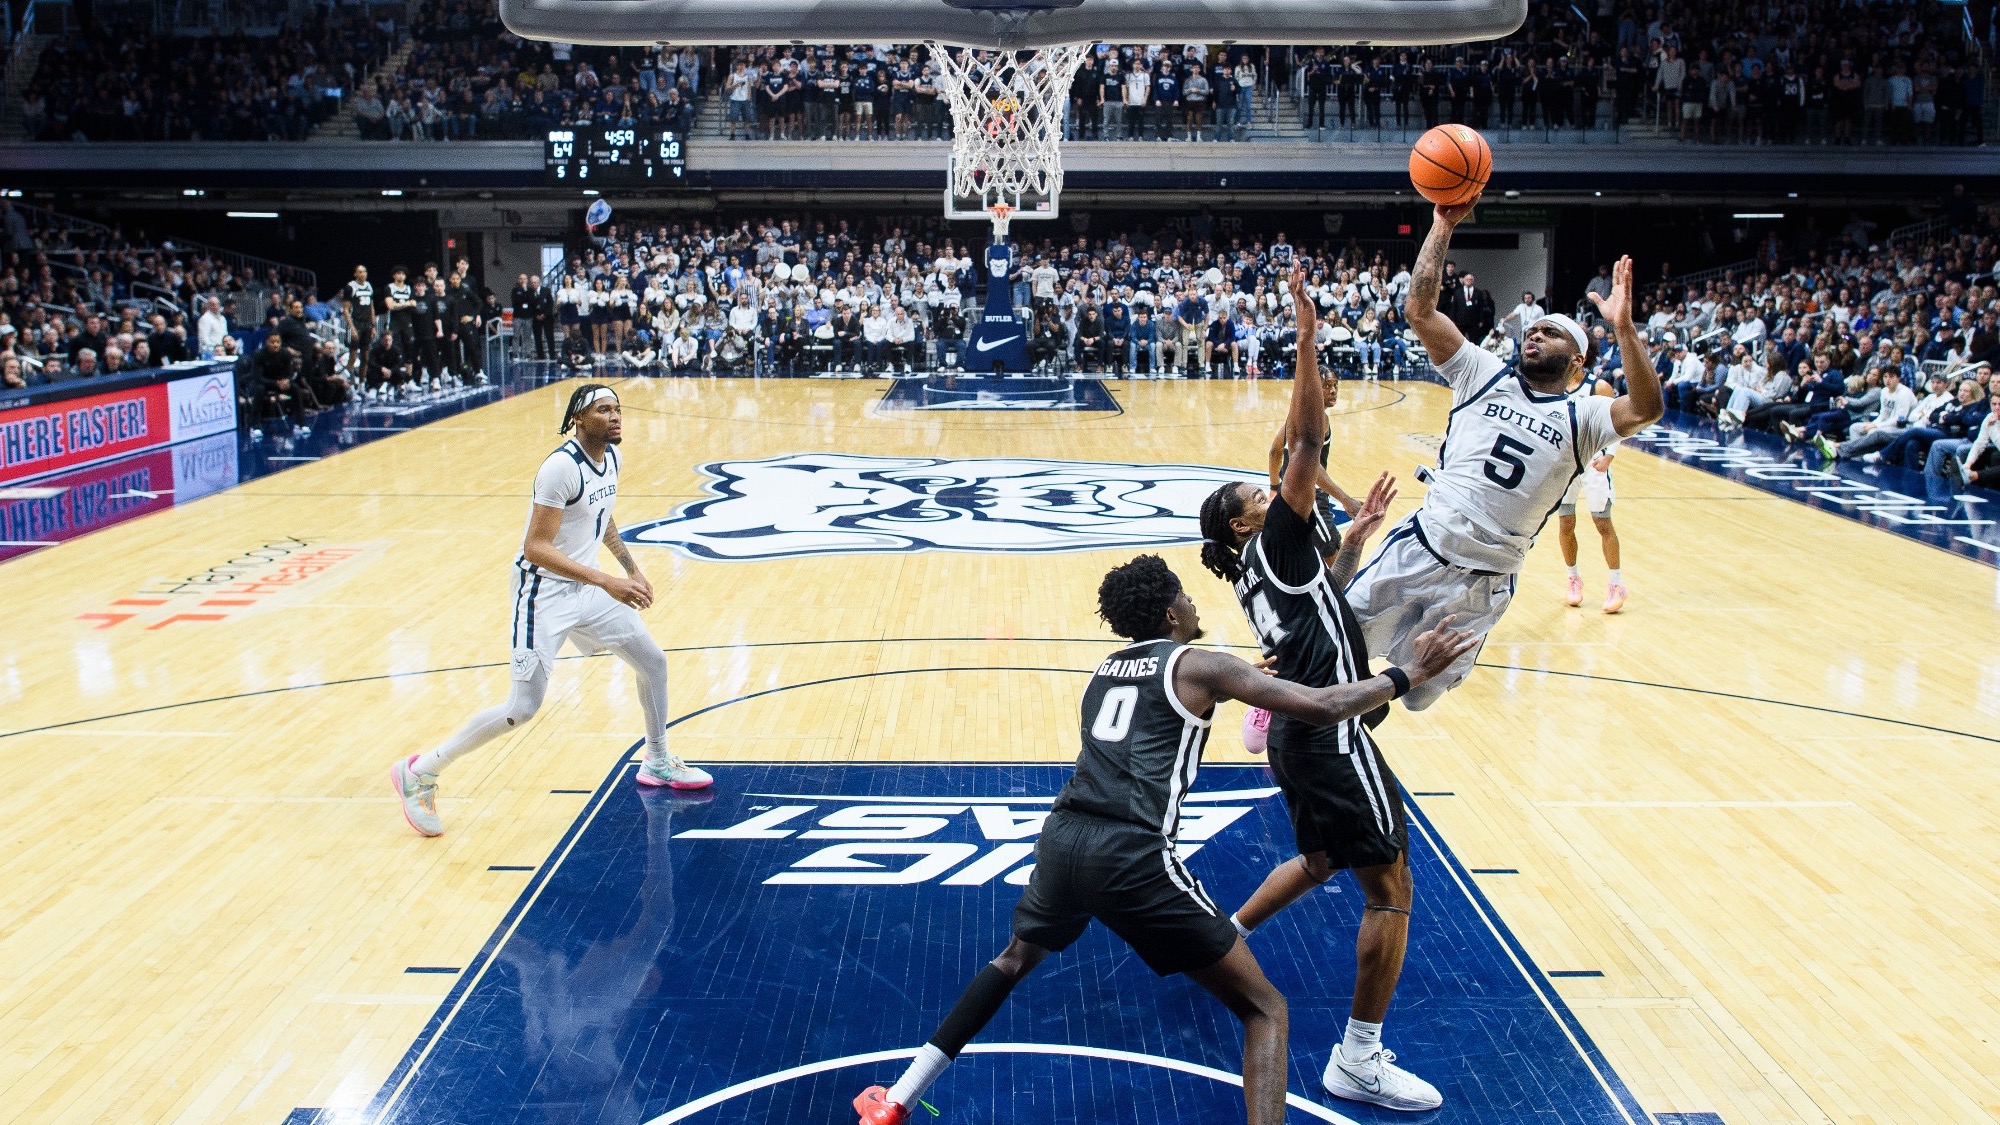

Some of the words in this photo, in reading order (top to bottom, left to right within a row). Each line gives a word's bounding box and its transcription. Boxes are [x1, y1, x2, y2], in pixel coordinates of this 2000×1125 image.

[605, 130, 634, 146] 4:59
[553, 143, 573, 158] 64
[610, 149, 620, 162] 2
[660, 142, 680, 158] 68
[557, 165, 566, 178] 5
[579, 165, 588, 178] 2
[673, 166, 682, 177] 4
[985, 315, 1013, 323] BUTLER
[67, 398, 148, 453] FASTER!
[1482, 403, 1564, 450] BUTLER
[1483, 433, 1535, 490] 5
[1630, 424, 1996, 525] FIELDHOUS
[588, 484, 617, 506] BUTLER
[594, 507, 606, 541] 1
[1097, 656, 1159, 678] GAINES
[1091, 685, 1139, 743] 0
